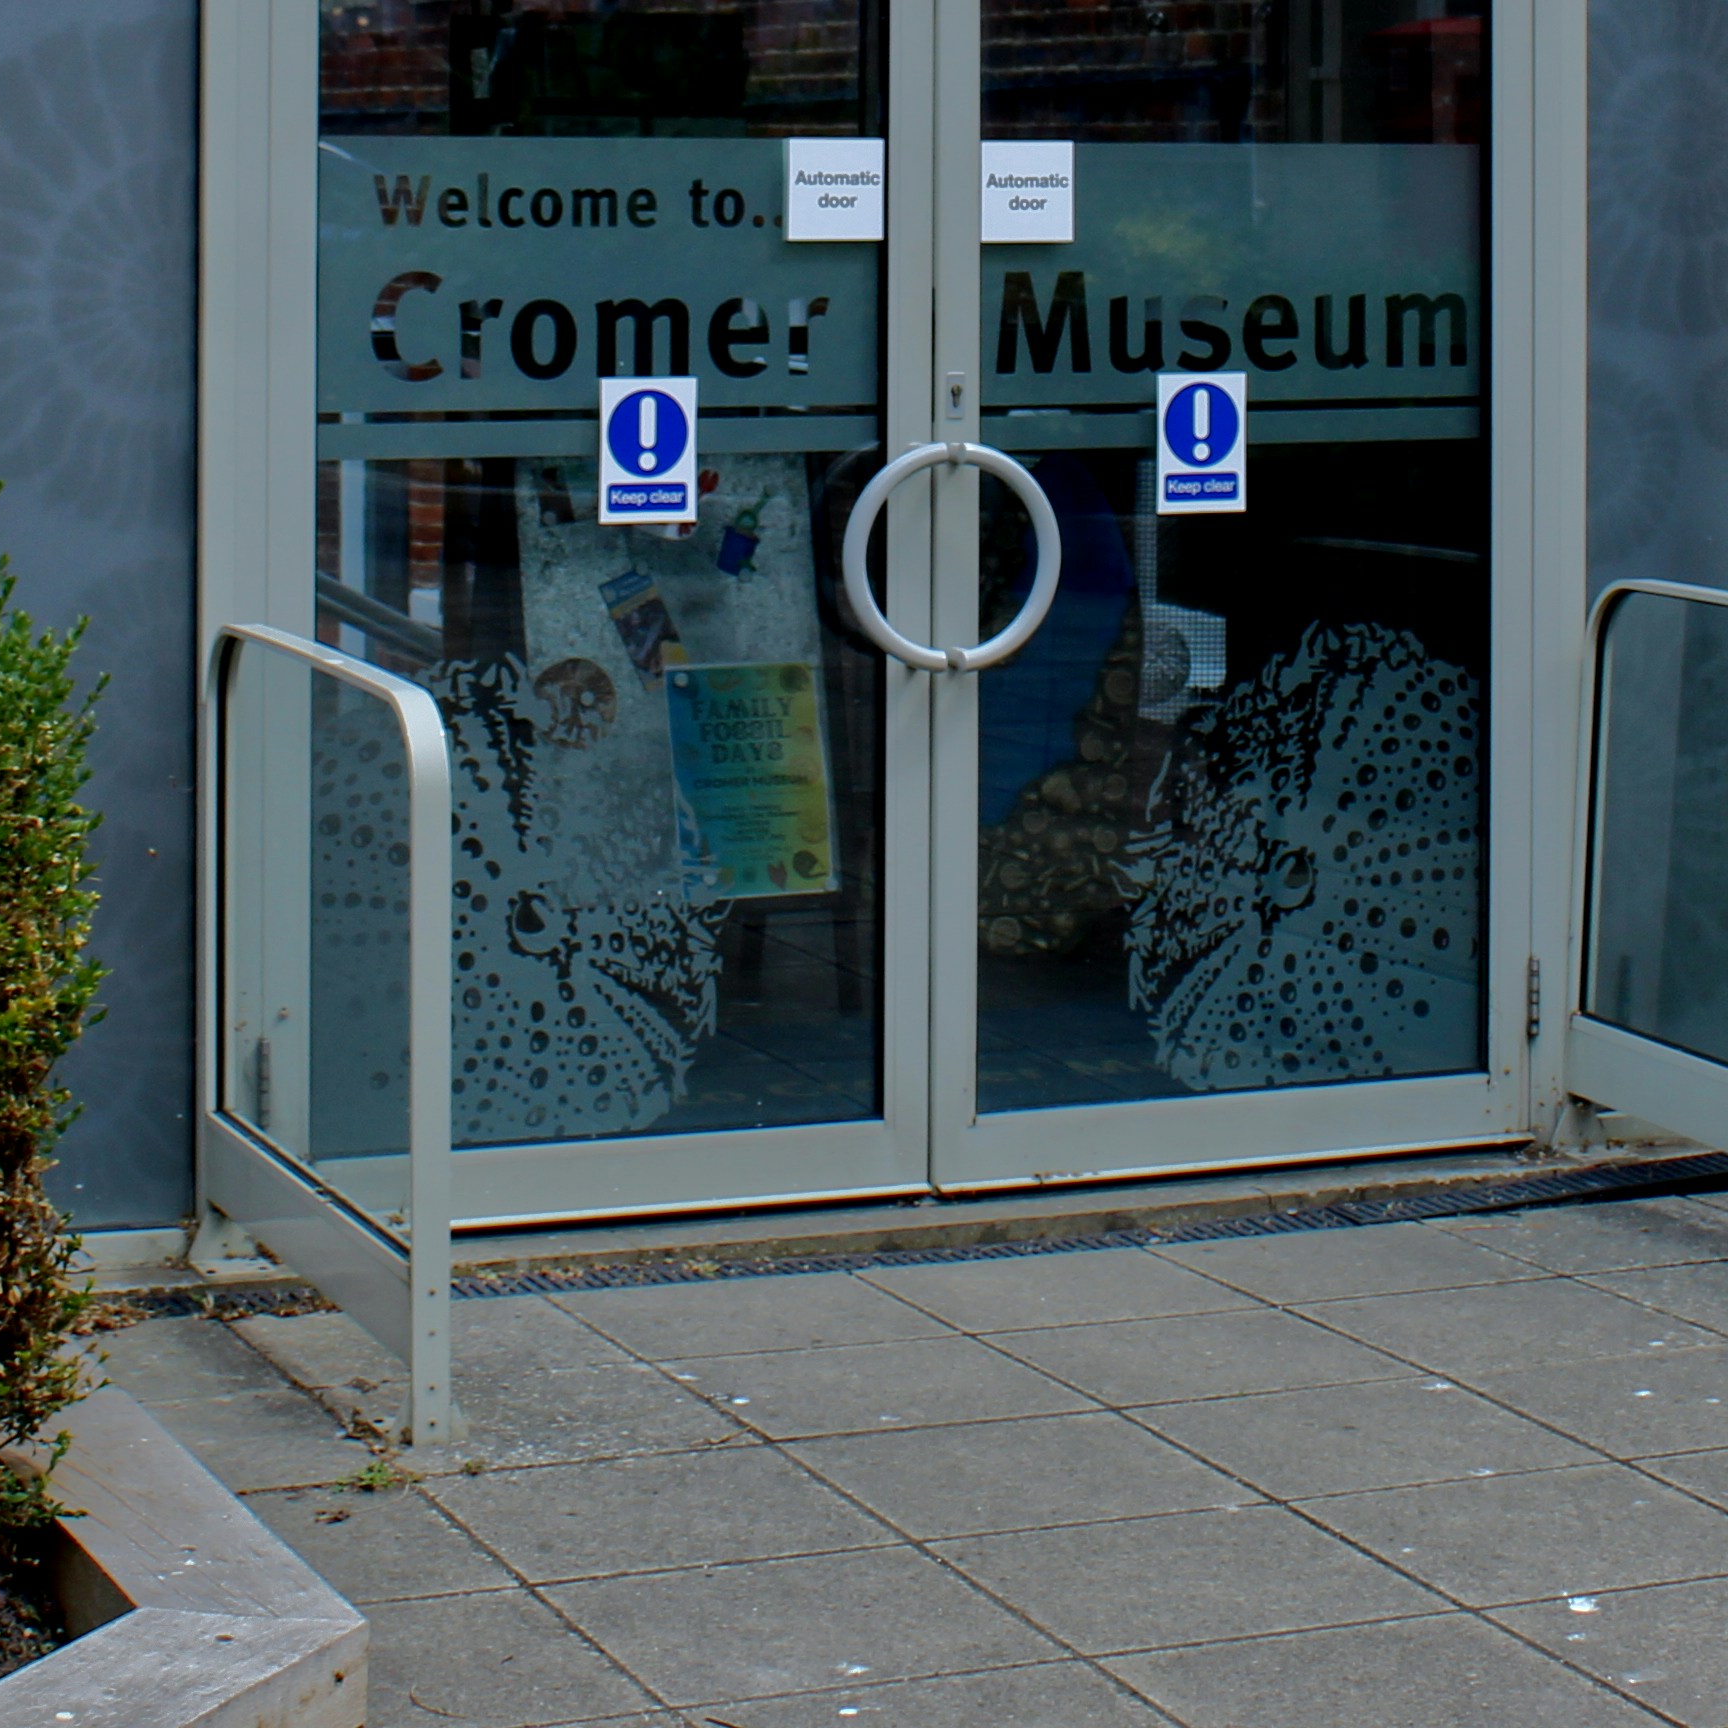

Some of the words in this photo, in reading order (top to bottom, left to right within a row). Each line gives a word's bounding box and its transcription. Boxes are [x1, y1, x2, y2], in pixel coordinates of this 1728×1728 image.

[794, 170, 881, 187] Automatic
[986, 173, 1070, 189] Automatic
[373, 171, 658, 229] Welcome
[817, 193, 858, 208] door
[1008, 195, 1048, 211] door
[370, 271, 830, 381] Cromer
[995, 271, 1468, 374] Museum
[1167, 479, 1202, 496] Keep
[1203, 478, 1236, 493] clear
[610, 490, 647, 506] Keep
[649, 489, 685, 504] clear
[689, 696, 793, 720] FAMILY
[699, 719, 792, 742] FOSSIL
[711, 742, 784, 764] DAYS
